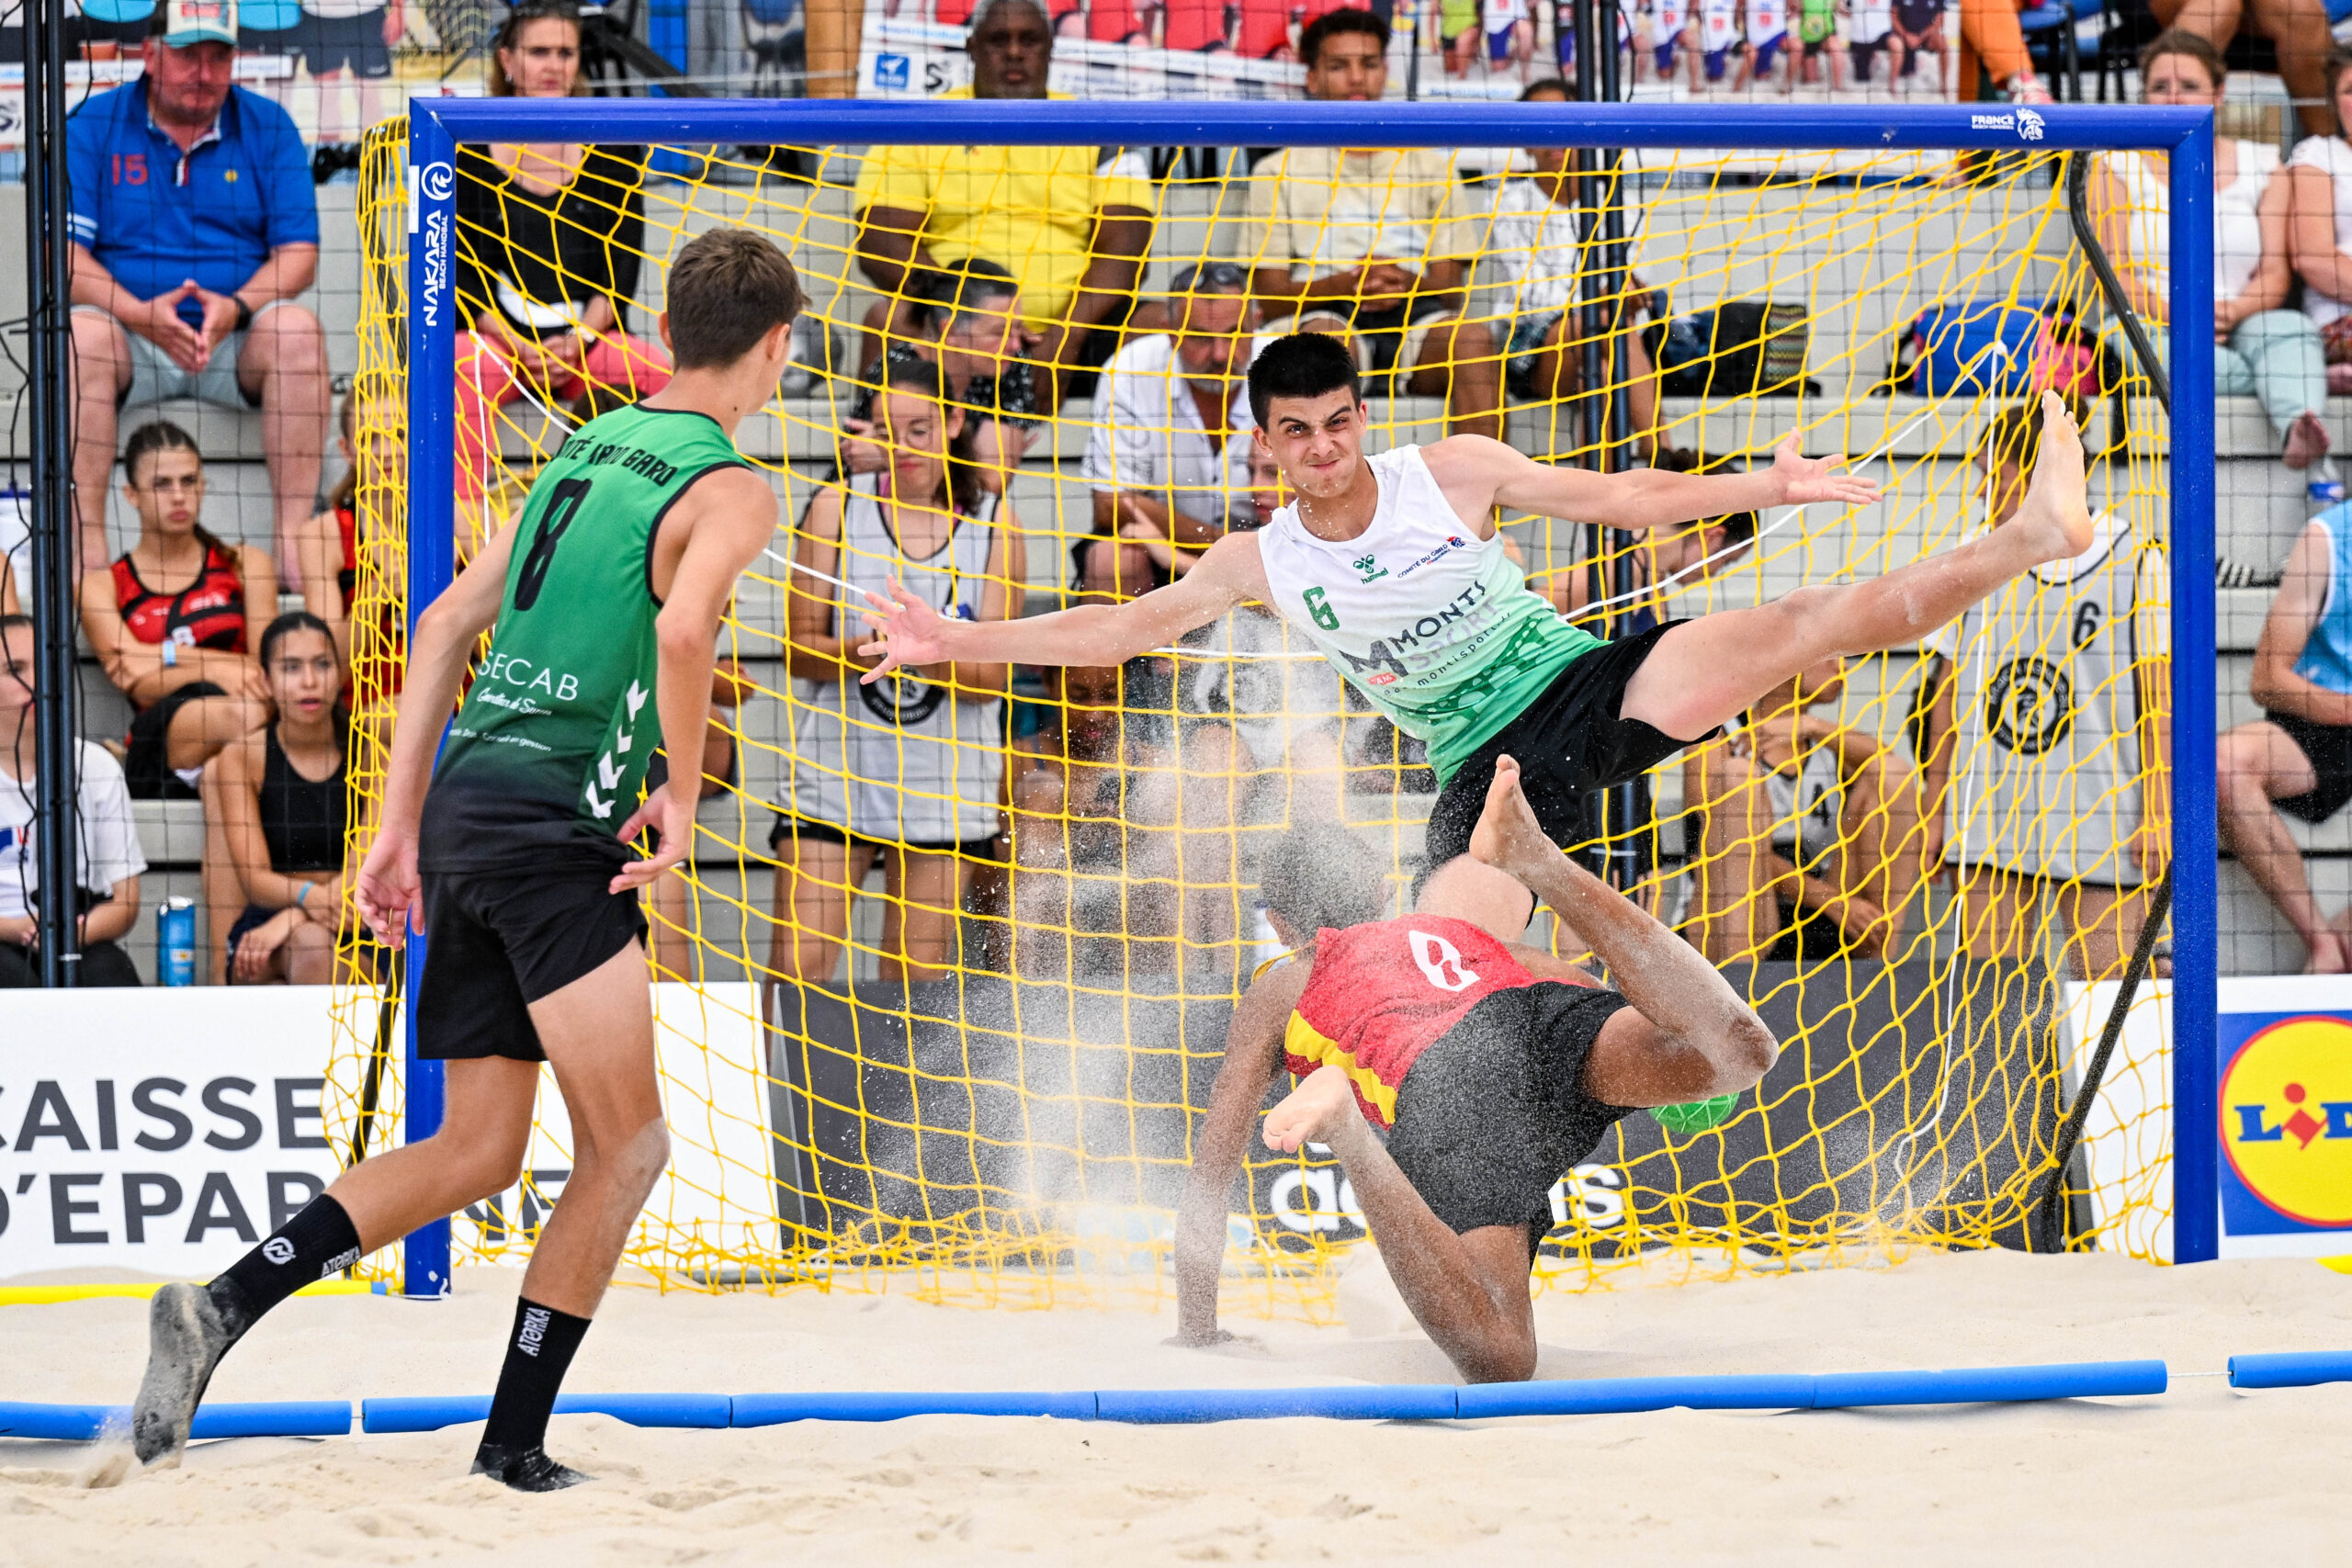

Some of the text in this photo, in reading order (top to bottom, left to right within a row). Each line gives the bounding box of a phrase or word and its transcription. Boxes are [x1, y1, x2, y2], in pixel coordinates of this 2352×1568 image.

[112, 153, 148, 185] 15
[423, 209, 441, 327] NAKARA
[438, 258, 447, 290] BEACH
[514, 478, 593, 611] 8
[1397, 560, 1421, 579] COMITÉ
[1420, 555, 1430, 563] DU
[1361, 567, 1389, 584] hummel
[1302, 586, 1340, 631] 6
[2073, 601, 2100, 651] 6
[1408, 597, 1498, 671] SPORT
[477, 650, 579, 701] SECAB
[1812, 784, 1830, 827] 4
[0, 1077, 332, 1152] AISSE
[322, 1246, 360, 1278] ATORKA
[517, 1306, 551, 1358] ATORKA
